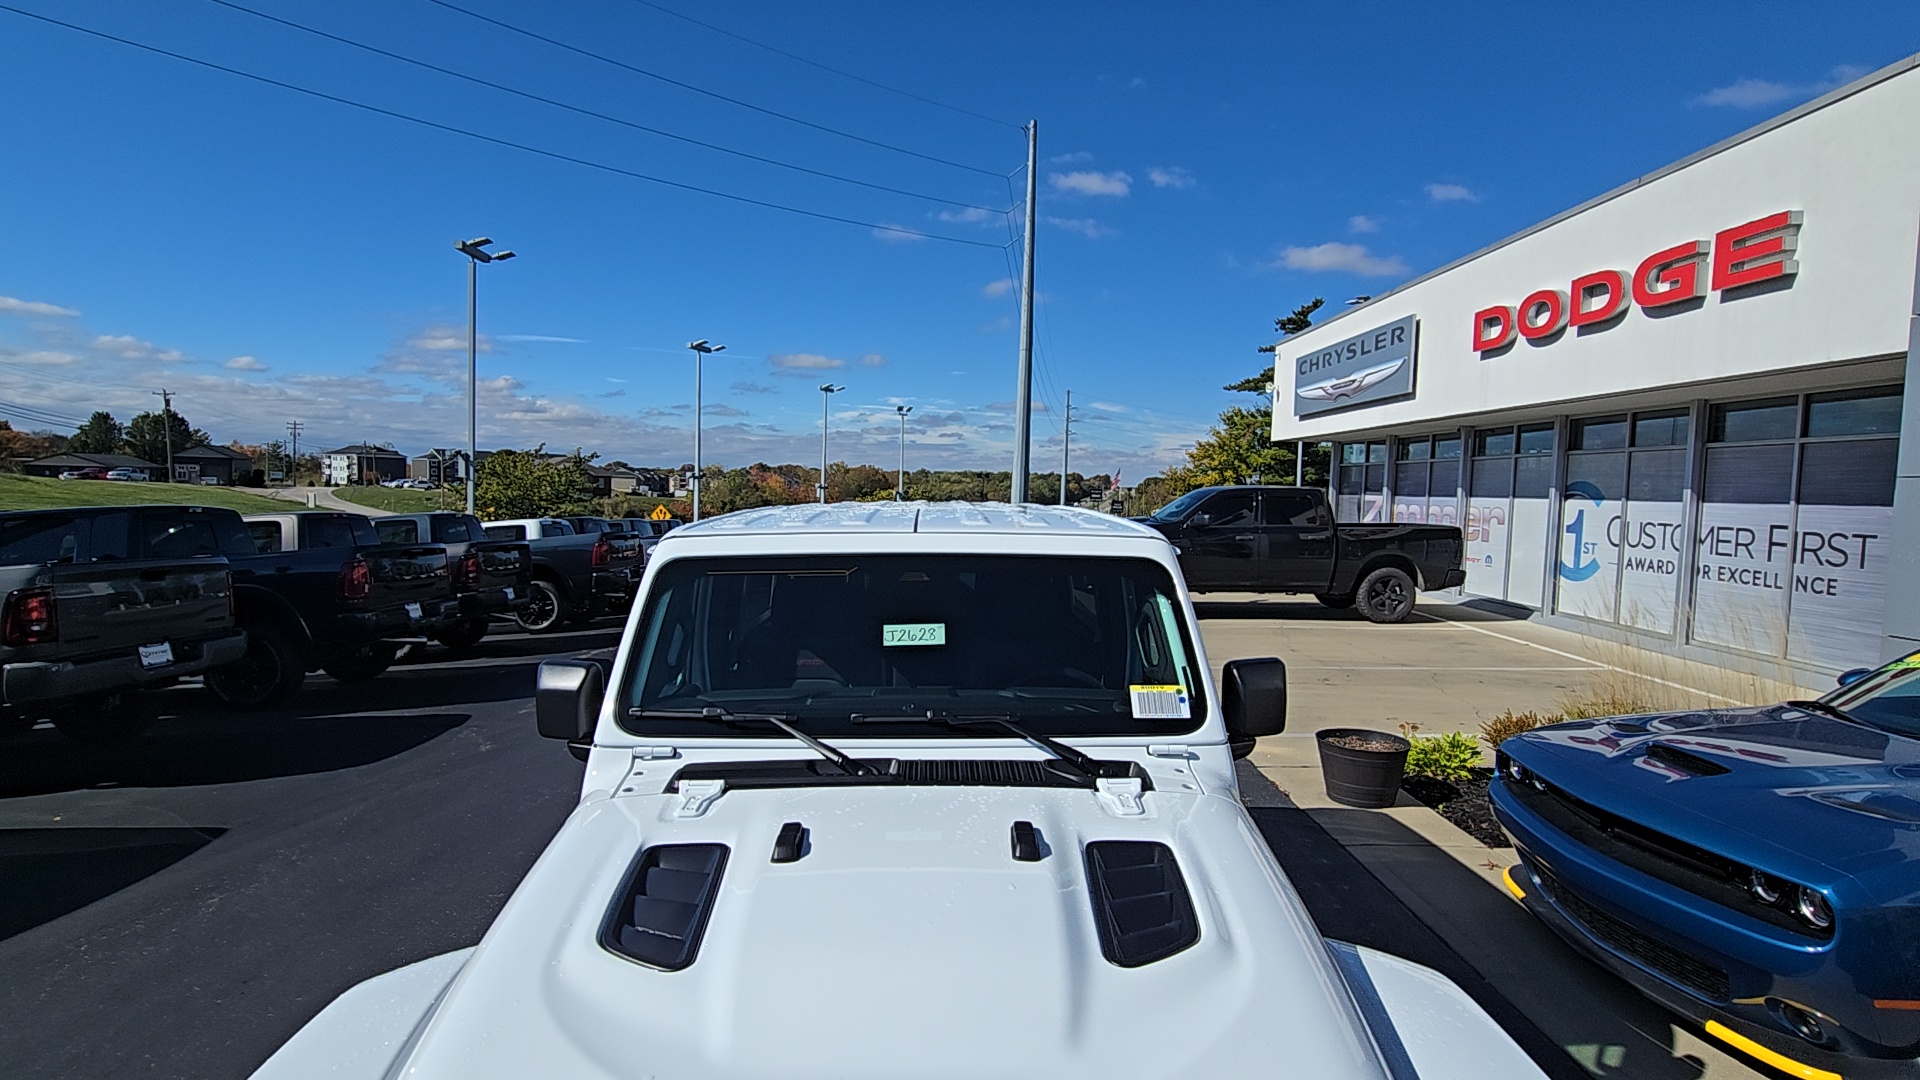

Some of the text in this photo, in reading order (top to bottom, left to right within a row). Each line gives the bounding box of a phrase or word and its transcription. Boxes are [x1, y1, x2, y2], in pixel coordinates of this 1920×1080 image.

[1473, 210, 1803, 353] DODGE
[1299, 325, 1405, 376] CHRYSLER
[1358, 495, 1505, 543] Zmmer
[1767, 524, 1879, 570] FIRST
[1625, 556, 1676, 575] AWARD
[1717, 566, 1838, 596] EXCELLNCE
[885, 627, 937, 642] J2628
